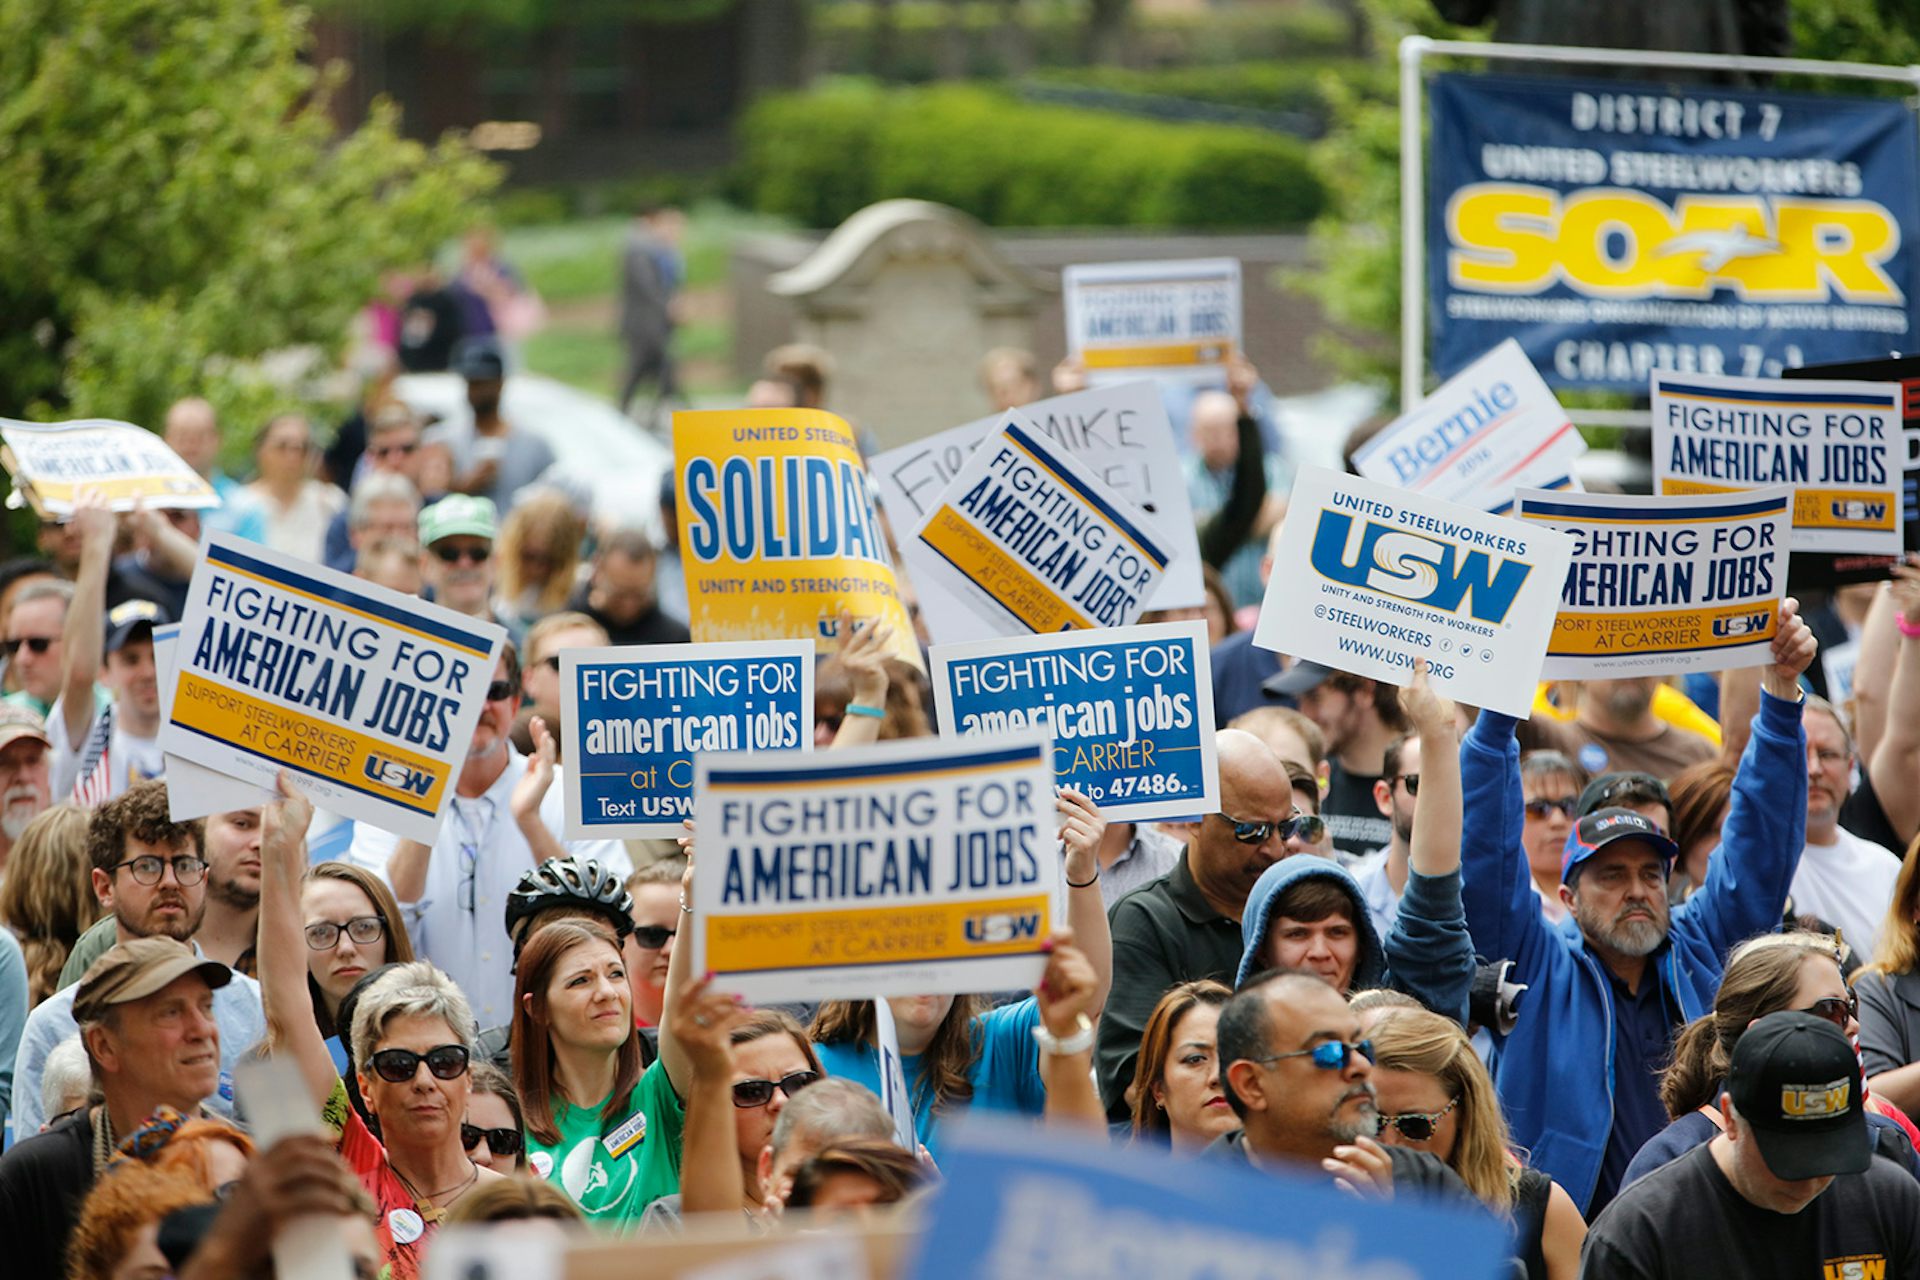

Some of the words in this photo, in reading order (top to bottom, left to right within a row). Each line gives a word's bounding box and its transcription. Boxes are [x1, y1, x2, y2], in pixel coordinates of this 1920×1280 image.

[1571, 91, 1745, 140] DISTRICT
[1758, 103, 1783, 142] 7
[1482, 144, 1608, 184] UNITED
[1610, 150, 1863, 196] STEELWORKERS
[1446, 181, 1905, 306] SOAR
[1553, 340, 1725, 377] CHAPTER
[733, 427, 799, 442] UNITED
[1386, 381, 1519, 483] Bernie
[1668, 404, 1811, 438] FIGHTING
[1825, 415, 1884, 439] FOR
[1670, 435, 1809, 483] AMERICAN
[1819, 445, 1887, 485] JOBS
[989, 448, 1108, 552] FIGHTING
[1105, 544, 1151, 594] FOR
[1332, 491, 1394, 520] UNITED
[1398, 510, 1528, 556] STEELWORKERS
[1831, 499, 1887, 522] USW
[958, 475, 1088, 591] AMERICAN
[1072, 568, 1137, 628] JOBS
[1560, 528, 1699, 558] GHTING
[1712, 522, 1775, 553] FOR
[699, 579, 745, 594] UNITY
[751, 578, 786, 593] AND
[791, 577, 870, 594] STRENGTH
[1309, 507, 1535, 625] USW
[1561, 561, 1694, 607] MERICAN
[1702, 552, 1775, 602] JOBS
[976, 566, 997, 581] AT
[995, 578, 1053, 630] CARRIER
[1321, 583, 1351, 599] UNITY
[1352, 593, 1374, 605] AND
[1376, 599, 1424, 619] STRENGTH
[1425, 612, 1445, 625] FOR
[1447, 618, 1495, 638] WORKERS
[206, 575, 381, 661] FIGHTING
[391, 641, 470, 694] FOR
[1314, 604, 1432, 648] @STEELWORKERS
[1554, 618, 1592, 632] PORT
[1596, 615, 1702, 631] STEELWORKERS
[1594, 633, 1616, 649] AT
[1621, 629, 1701, 648] CARRIER
[1712, 611, 1771, 637] USW
[582, 664, 740, 700] FIGHTING
[747, 662, 797, 695] FOR
[953, 650, 1116, 697] FIGHTING
[1125, 645, 1188, 679] FOR
[1338, 636, 1455, 680] WWW.USWORG
[192, 617, 366, 722] AMERICAN
[363, 677, 461, 753] JOBS
[185, 682, 243, 713] SUPPORT
[244, 704, 357, 755] STEELWORKERS
[585, 704, 738, 755] american
[745, 700, 798, 755] jobs
[1118, 683, 1193, 748] jobs
[240, 723, 261, 743] AT
[263, 730, 351, 775] CARRIER
[363, 754, 437, 798] USW
[630, 765, 658, 789] at
[1088, 783, 1104, 800] to
[1109, 773, 1188, 798] 47486.
[598, 797, 636, 817] Text
[642, 796, 695, 817] USW
[721, 790, 938, 836] FIGHTING
[955, 779, 1034, 822] FOR
[721, 836, 933, 905] AMERICAN
[948, 824, 1038, 891] JOBS
[718, 921, 801, 941] SUPPORT
[809, 938, 836, 957] AT
[843, 932, 949, 957] CARRIER
[963, 914, 1042, 944] USW
[1782, 1083, 1850, 1115] USW
[1823, 1259, 1887, 1280] USW
